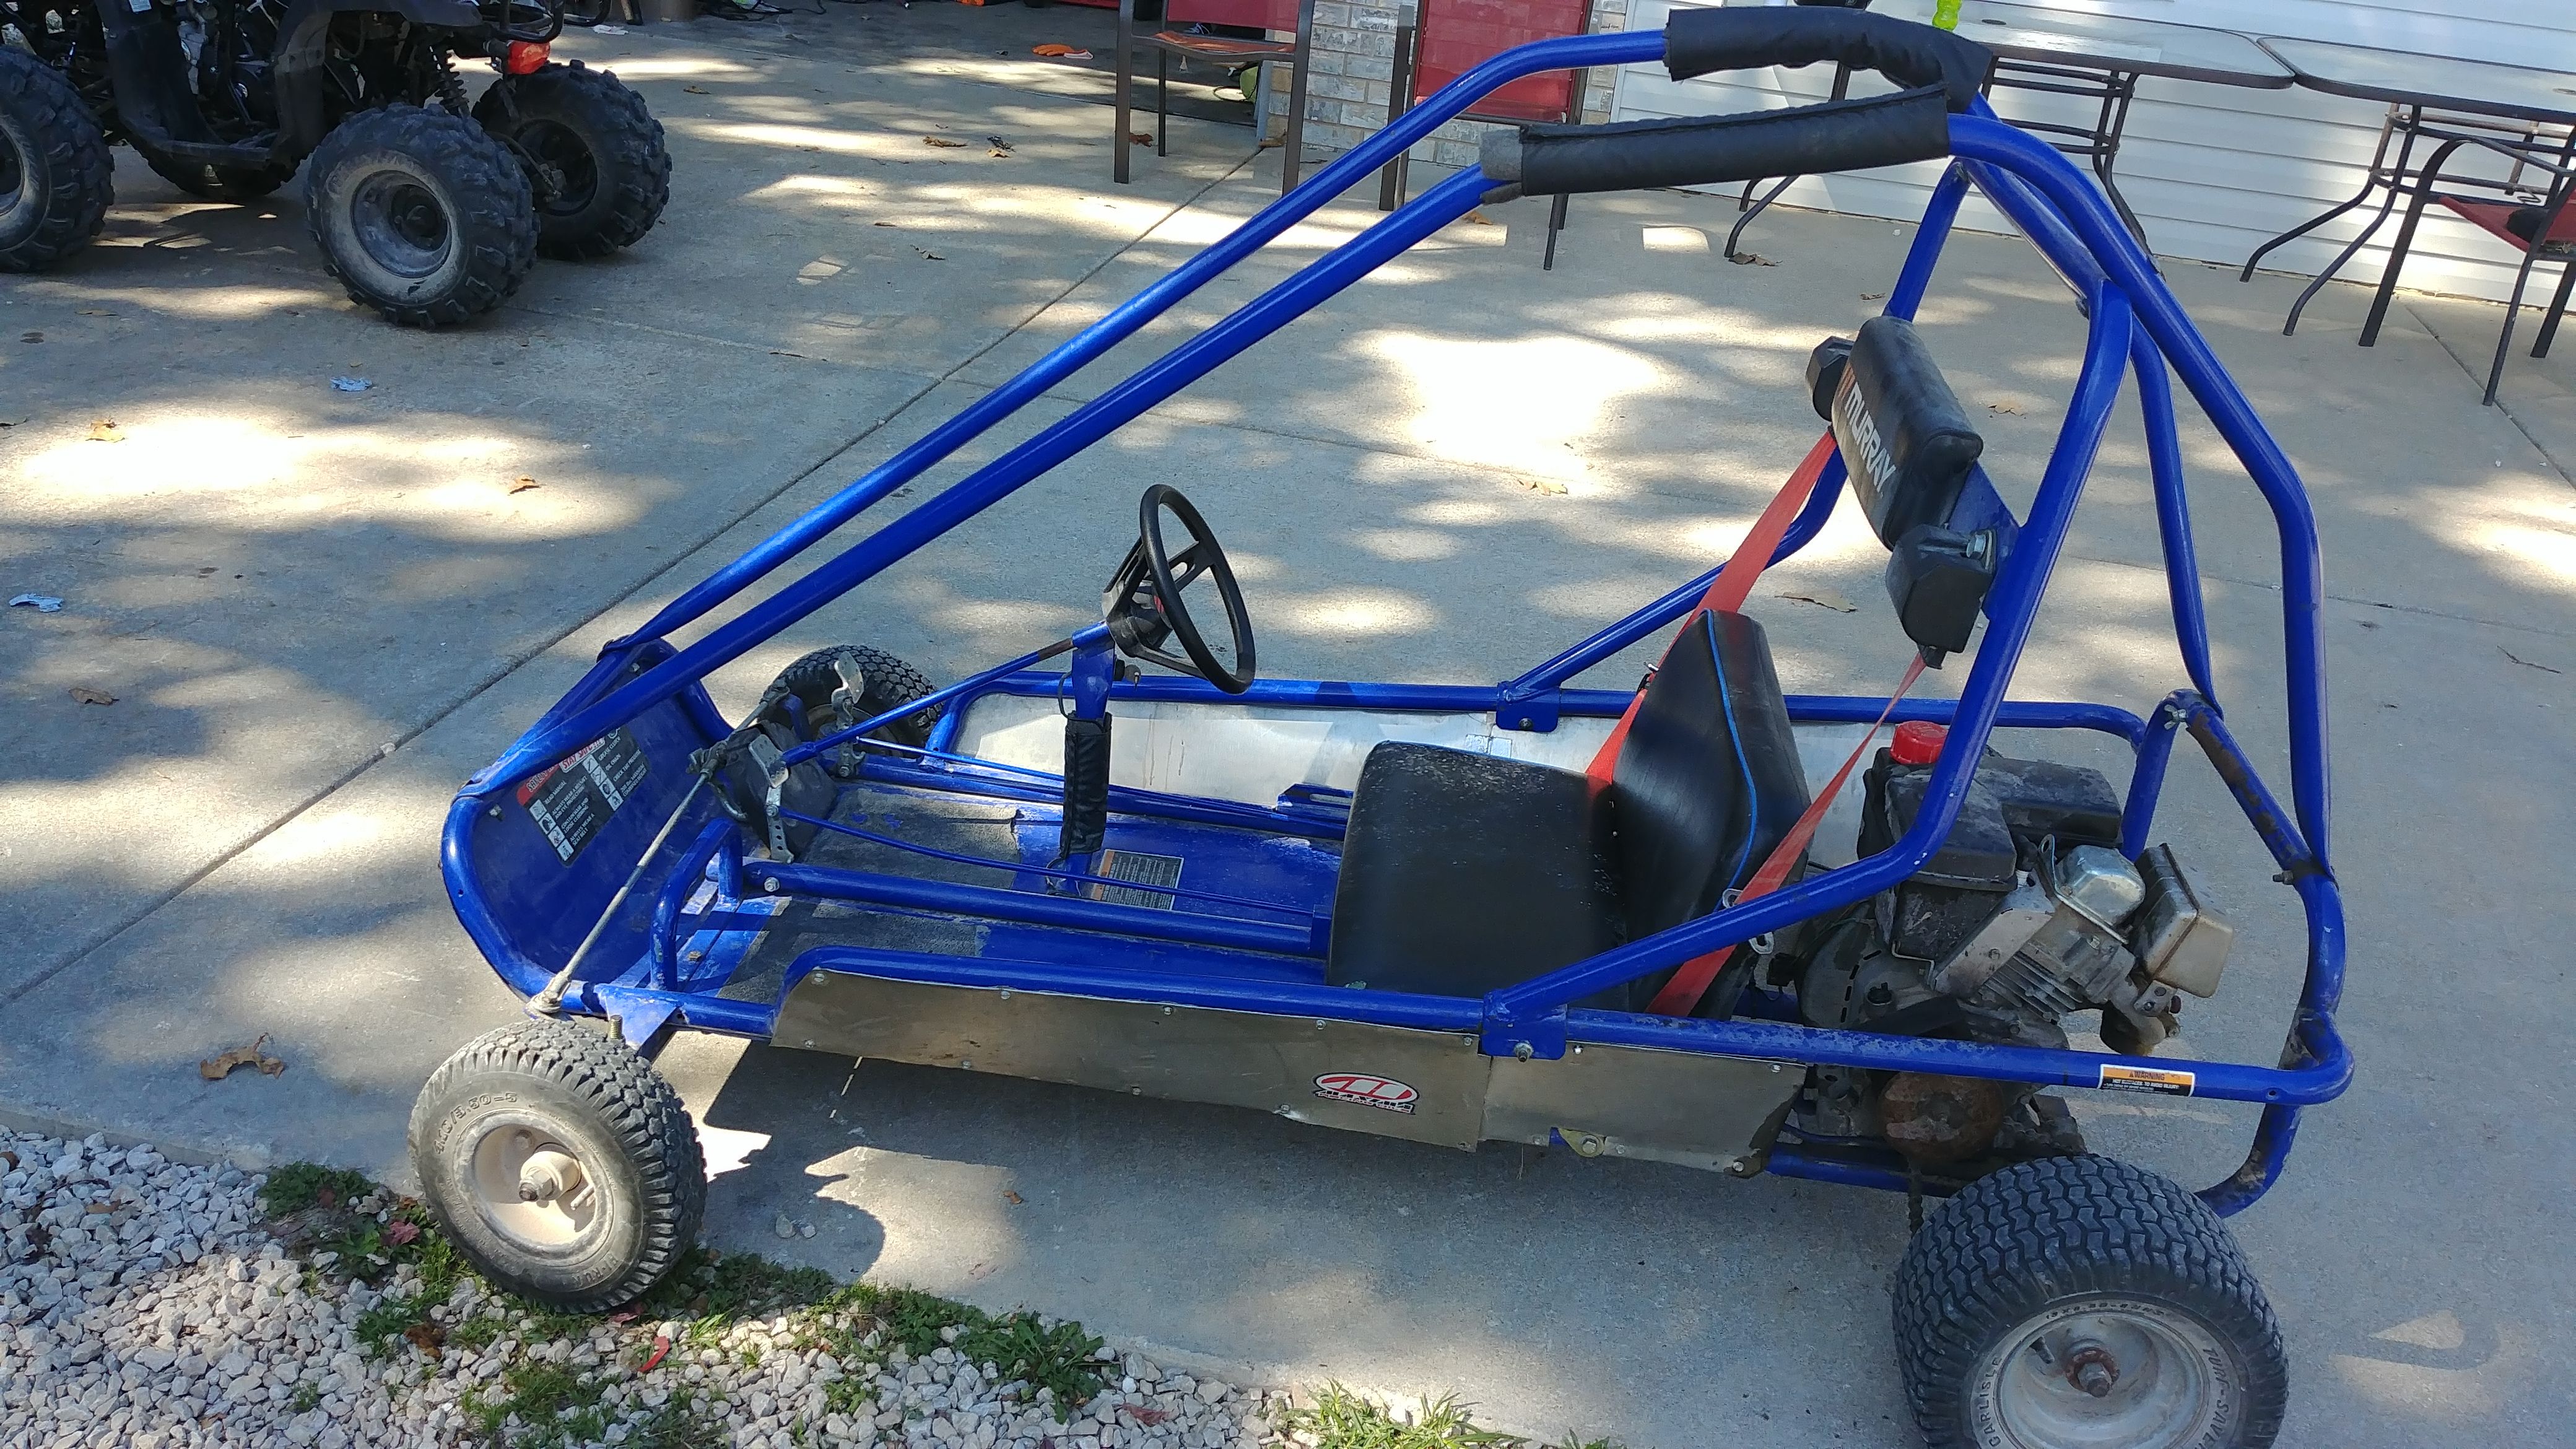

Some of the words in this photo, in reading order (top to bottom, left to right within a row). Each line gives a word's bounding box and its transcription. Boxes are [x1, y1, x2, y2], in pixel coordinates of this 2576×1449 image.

[1844, 381, 1897, 493] MURRAY
[2133, 1070, 2165, 1081] WARNING
[433, 1092, 518, 1155] 4.10/3.50-5
[1979, 1356, 2003, 1448] CARLISLE
